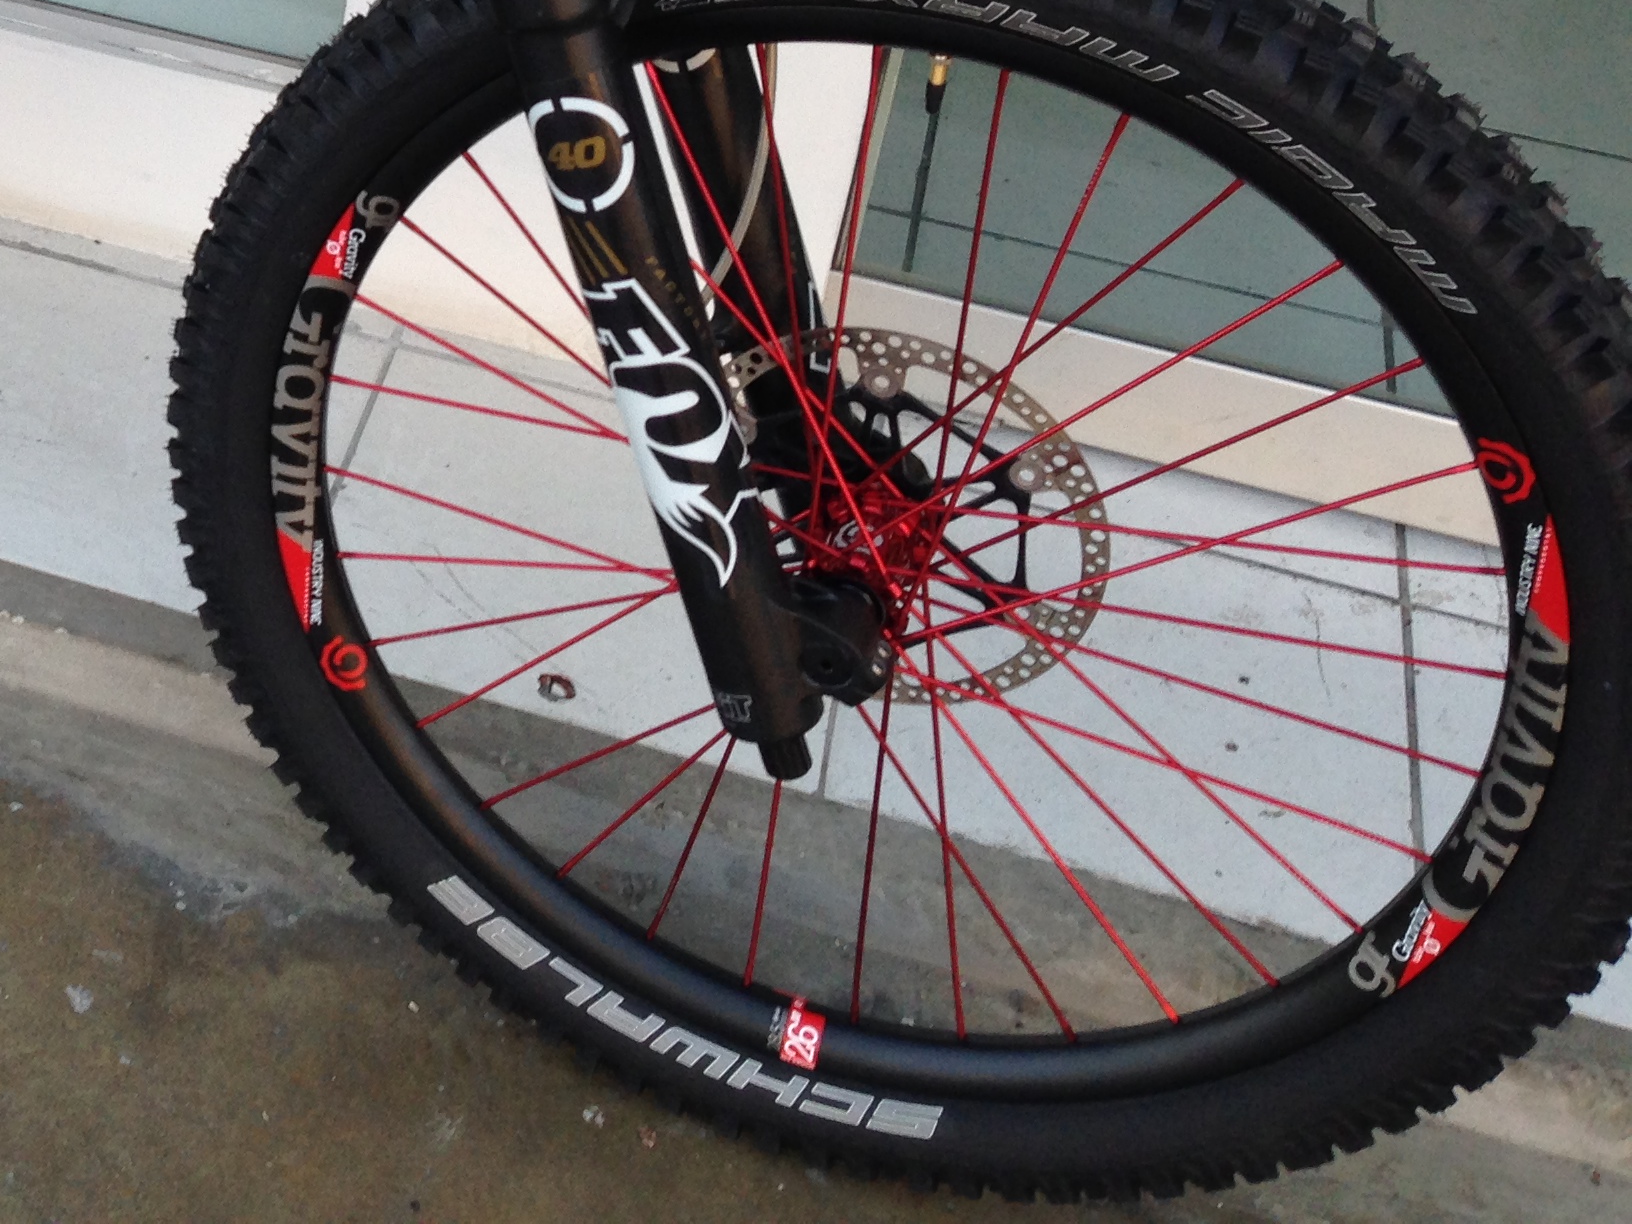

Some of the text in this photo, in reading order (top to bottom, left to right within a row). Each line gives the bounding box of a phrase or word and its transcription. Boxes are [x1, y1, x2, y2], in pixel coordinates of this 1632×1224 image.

[547, 134, 607, 172] 40
[1184, 88, 1478, 315] MAGIC
[270, 275, 357, 554] Gravity
[1422, 608, 1571, 924] Gravity
[425, 874, 945, 1141] SCHWALBE
[1347, 929, 1397, 1000] gr
